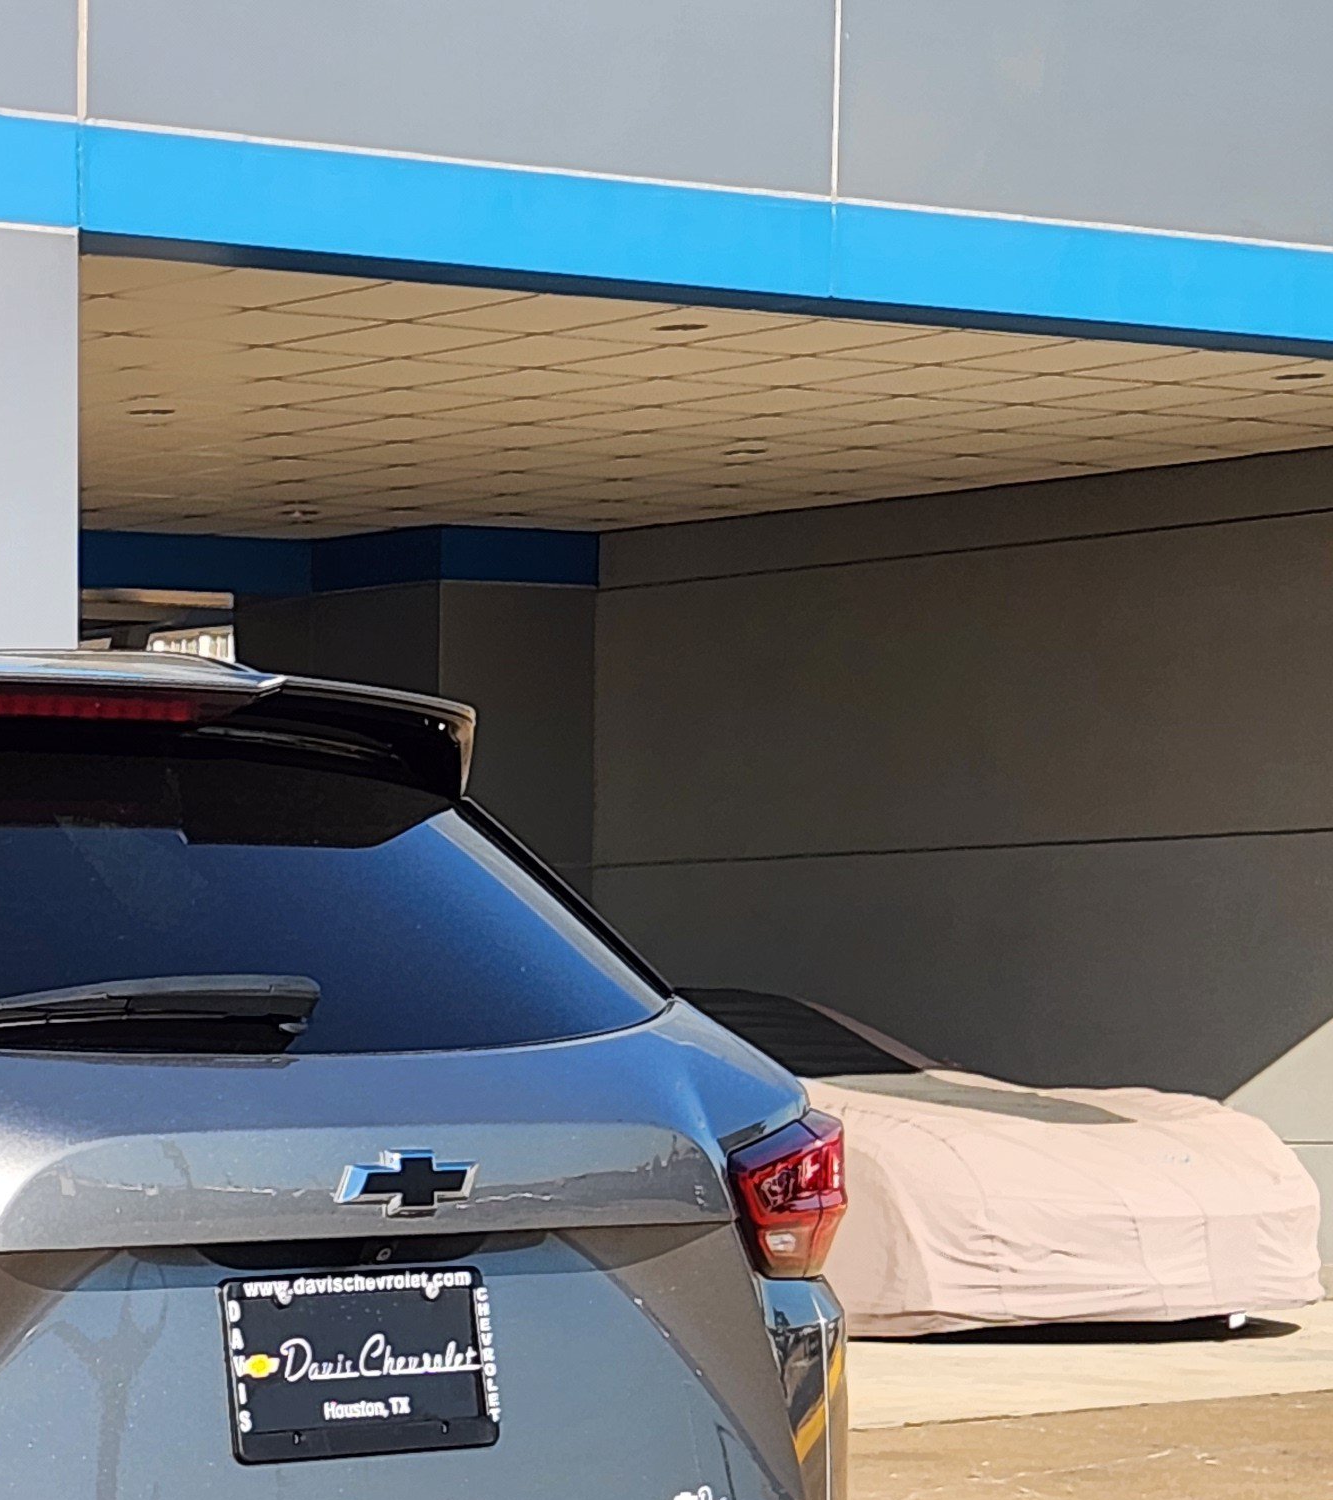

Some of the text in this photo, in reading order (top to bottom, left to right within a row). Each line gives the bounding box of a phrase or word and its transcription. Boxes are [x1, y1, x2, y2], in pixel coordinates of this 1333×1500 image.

[242, 1270, 472, 1298] www.davischevrolet.com
[280, 1333, 483, 1382] Davis Chevrolet
[476, 1287, 501, 1422] CHEVROLET
[323, 1396, 411, 1420] Houston, TX
